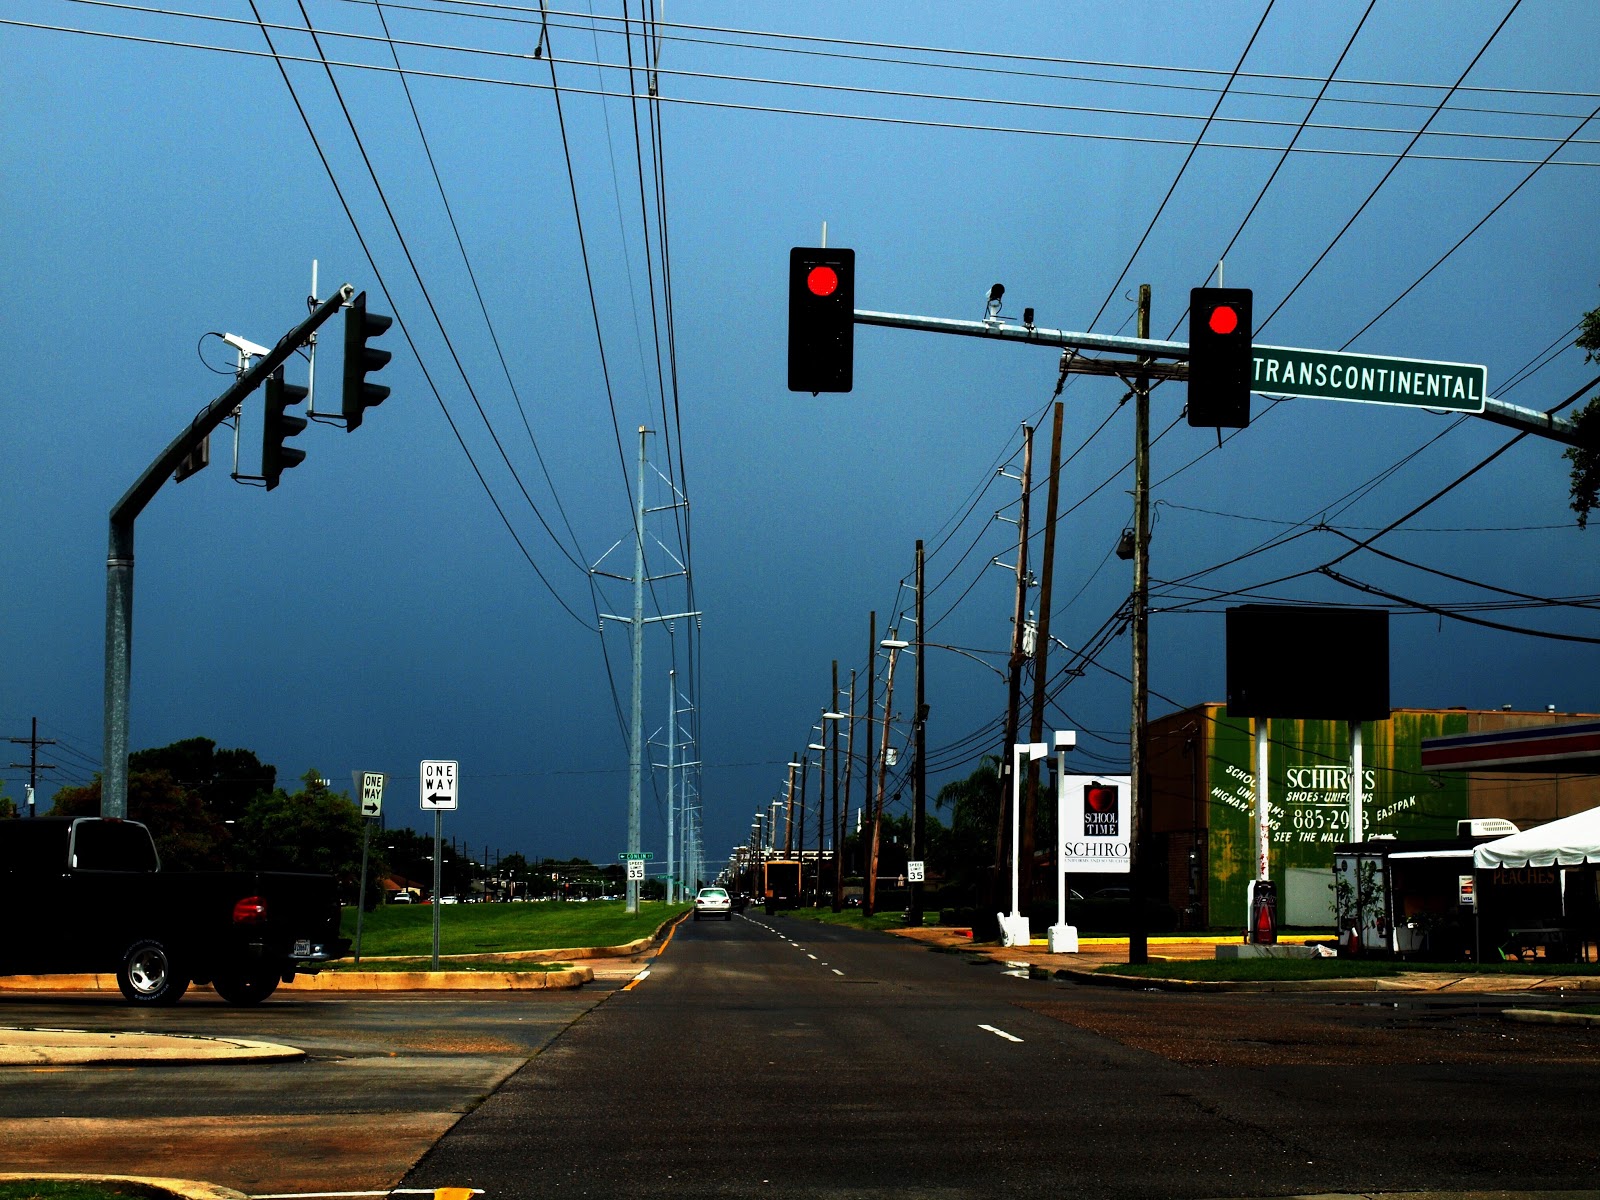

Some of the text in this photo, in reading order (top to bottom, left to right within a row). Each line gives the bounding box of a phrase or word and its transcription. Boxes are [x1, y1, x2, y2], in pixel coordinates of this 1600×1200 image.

[1253, 357, 1480, 401] TRANSCONTINENTAL
[426, 765, 453, 777] ONE
[1225, 765, 1256, 788] SCHOO
[365, 775, 382, 788] ONE
[425, 778, 453, 790] WAY
[1286, 769, 1376, 790] SCHIR'S
[364, 788, 381, 800] WAY
[1211, 786, 1281, 831] WIGWAM SKS
[1236, 786, 1285, 819] UNIRMS
[1376, 795, 1416, 822] EASTPAK
[1084, 813, 1118, 824] SCHOOL
[1293, 809, 1370, 830] 885-293
[1086, 824, 1116, 835] TIME
[1273, 831, 1293, 842] SEE
[1320, 832, 1345, 843] WALL
[1064, 841, 1131, 857] SCHIRO'
[629, 870, 643, 878] 35
[909, 871, 923, 880] 35
[1494, 868, 1555, 886] PEACHES
